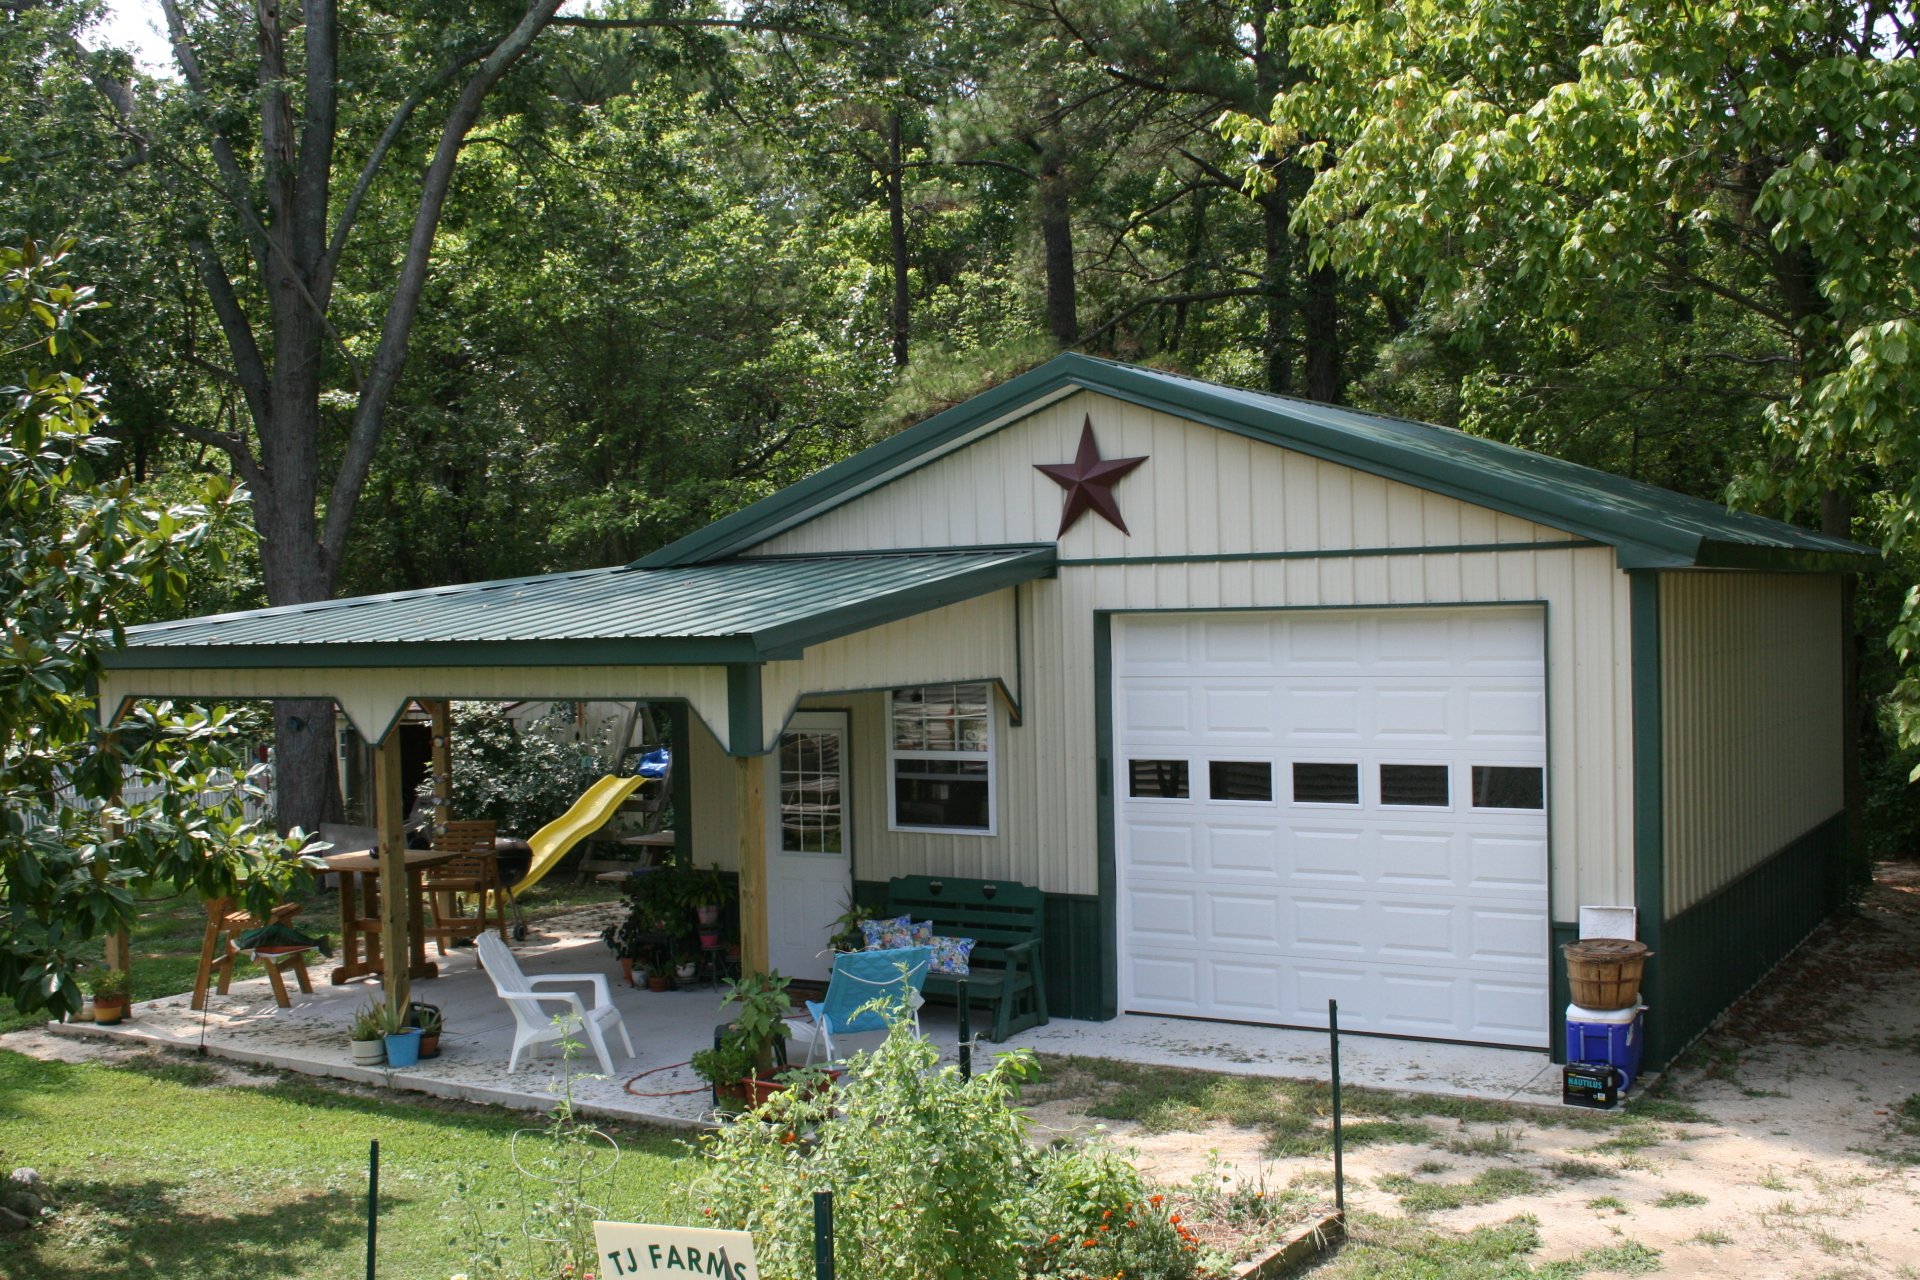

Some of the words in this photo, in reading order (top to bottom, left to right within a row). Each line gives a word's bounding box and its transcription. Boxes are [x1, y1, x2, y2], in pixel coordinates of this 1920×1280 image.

[1568, 1077, 1602, 1089] NAUTILUS
[608, 1247, 638, 1276] TJ
[648, 1244, 747, 1280] FARMS
